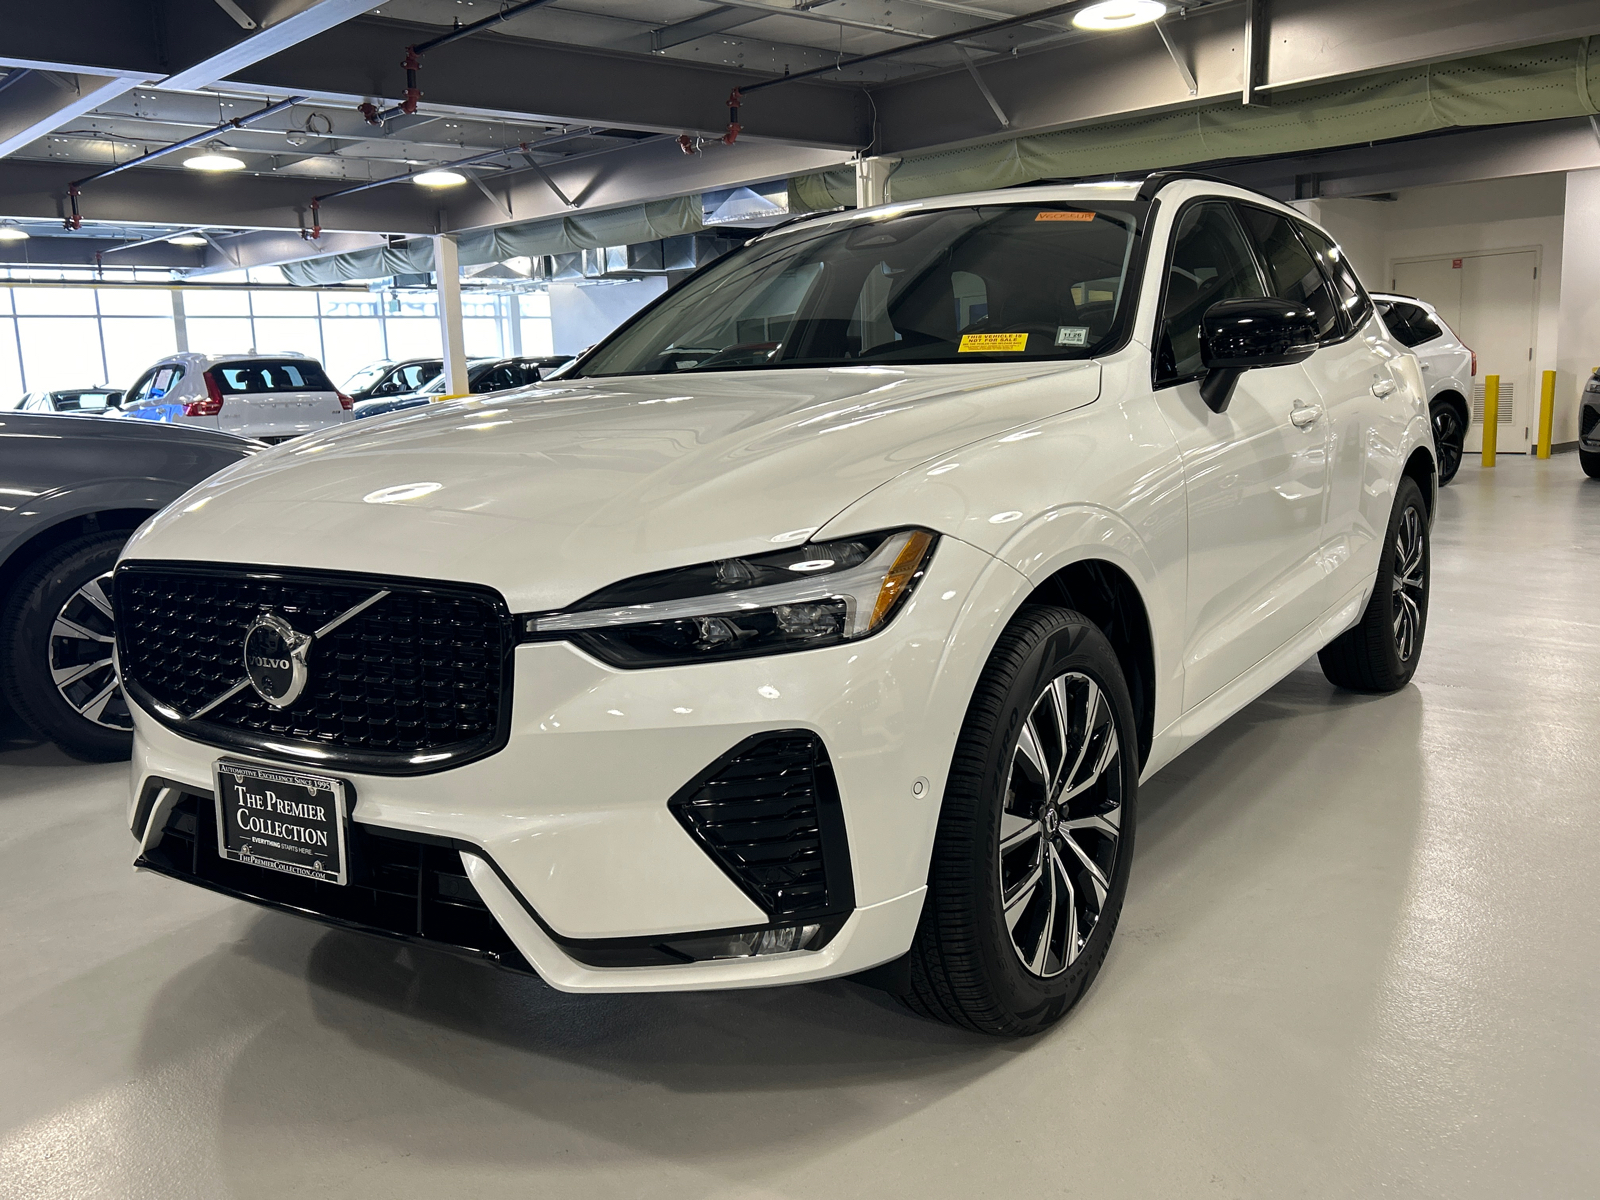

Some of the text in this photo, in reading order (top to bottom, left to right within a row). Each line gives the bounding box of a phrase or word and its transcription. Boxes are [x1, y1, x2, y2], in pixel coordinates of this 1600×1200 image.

[248, 656, 290, 670] VOLVO
[314, 780, 331, 790] 1995
[251, 836, 281, 849] EVERYTHING
[281, 842, 298, 853] STARTS
